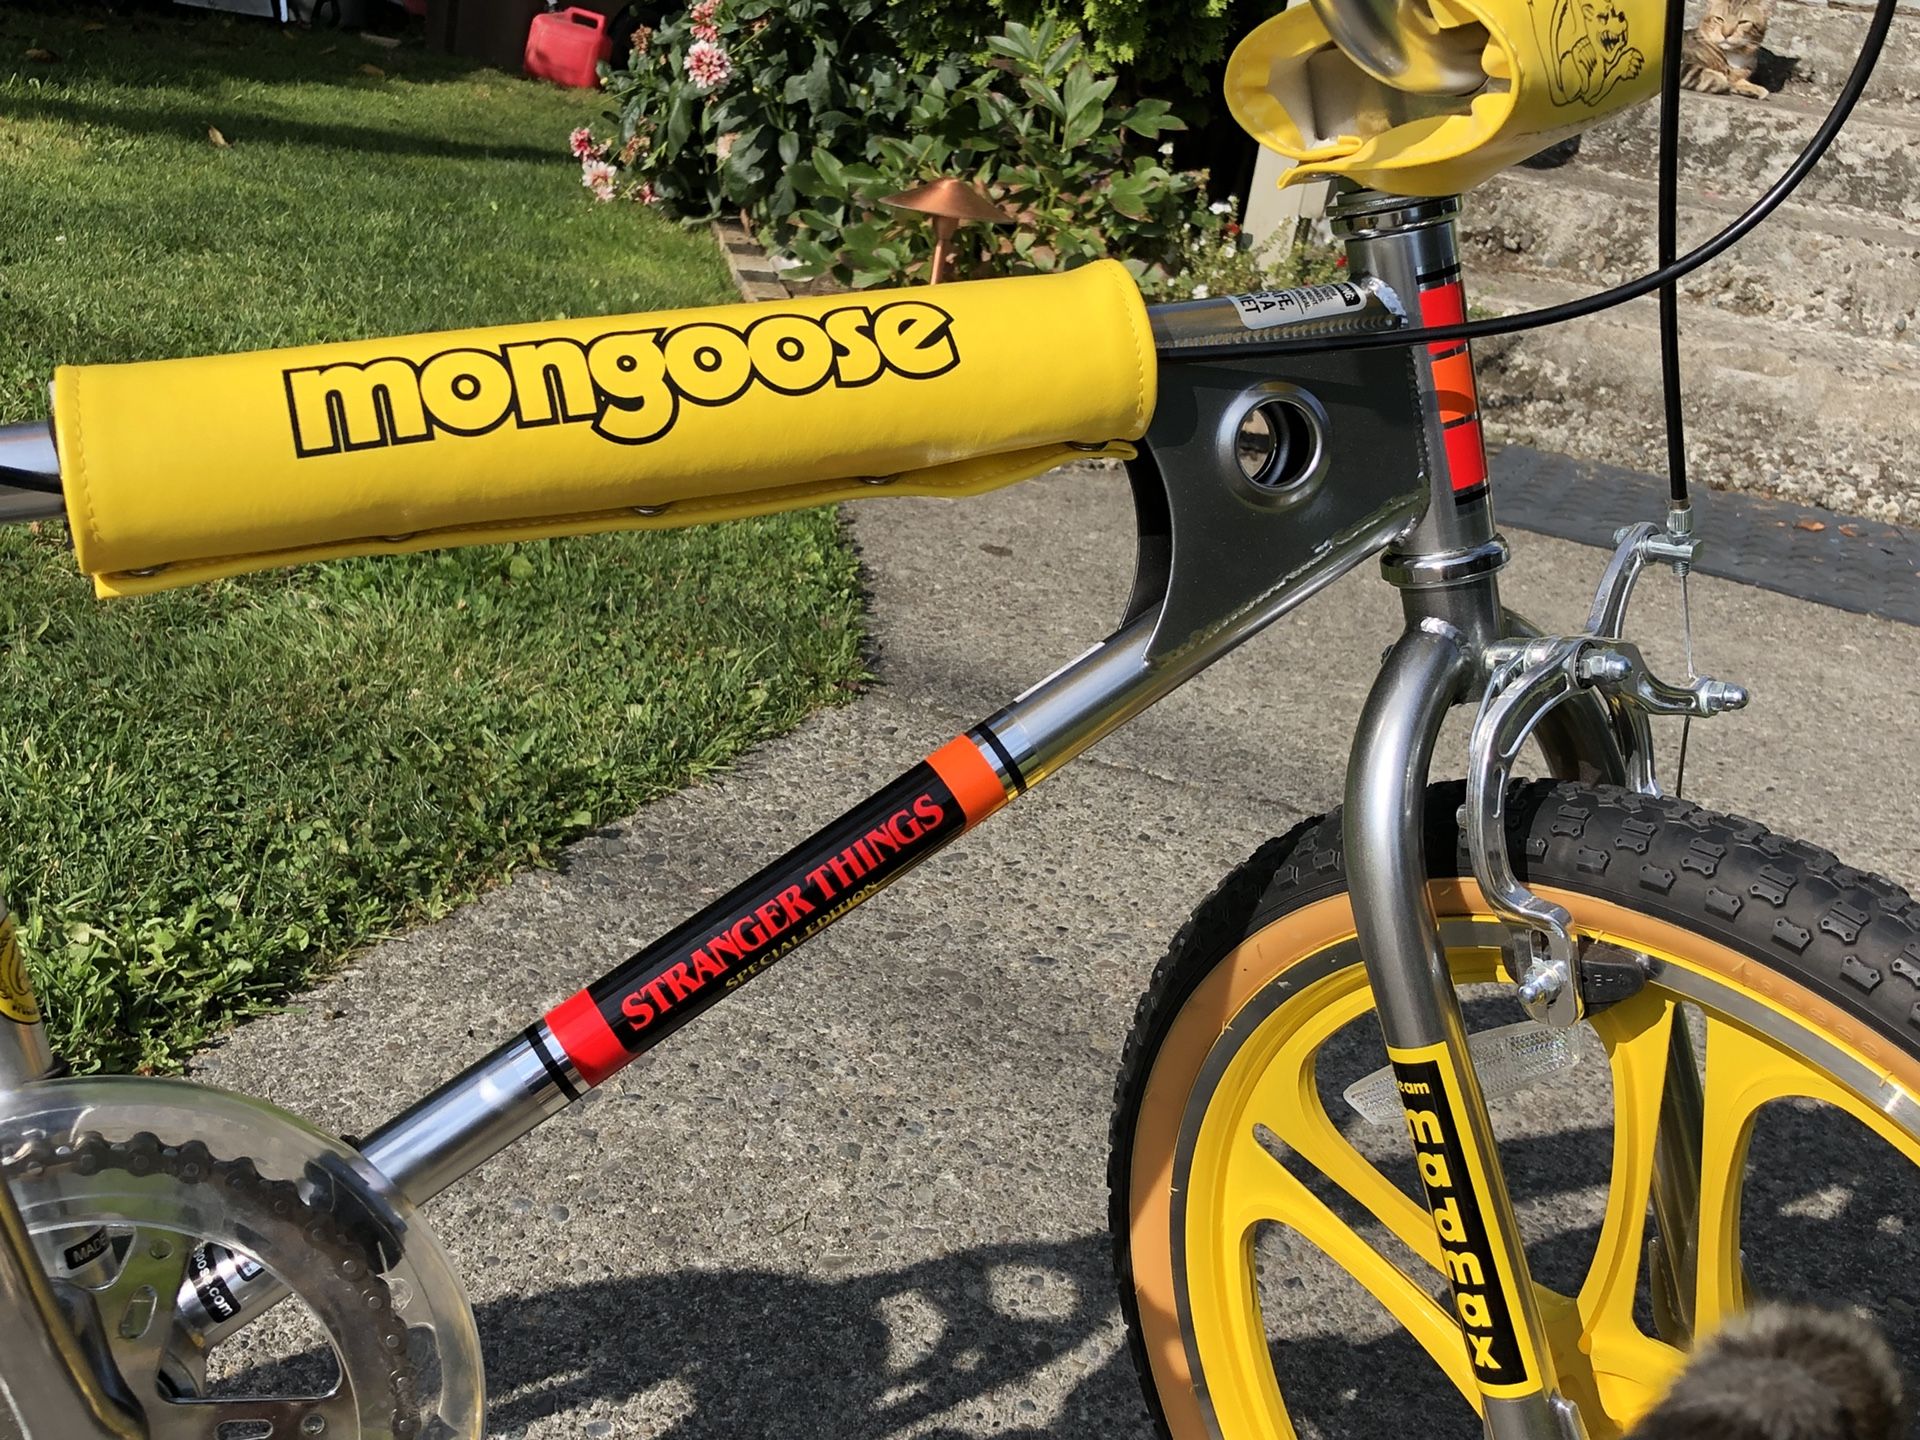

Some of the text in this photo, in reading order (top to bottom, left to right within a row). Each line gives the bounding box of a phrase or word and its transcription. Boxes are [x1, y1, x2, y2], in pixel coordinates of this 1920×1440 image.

[282, 301, 961, 459] mongoose
[621, 793, 945, 1031] STRANGER THINGS
[725, 881, 879, 990] SPECIAL EDITION
[1396, 1081, 1431, 1095] eam
